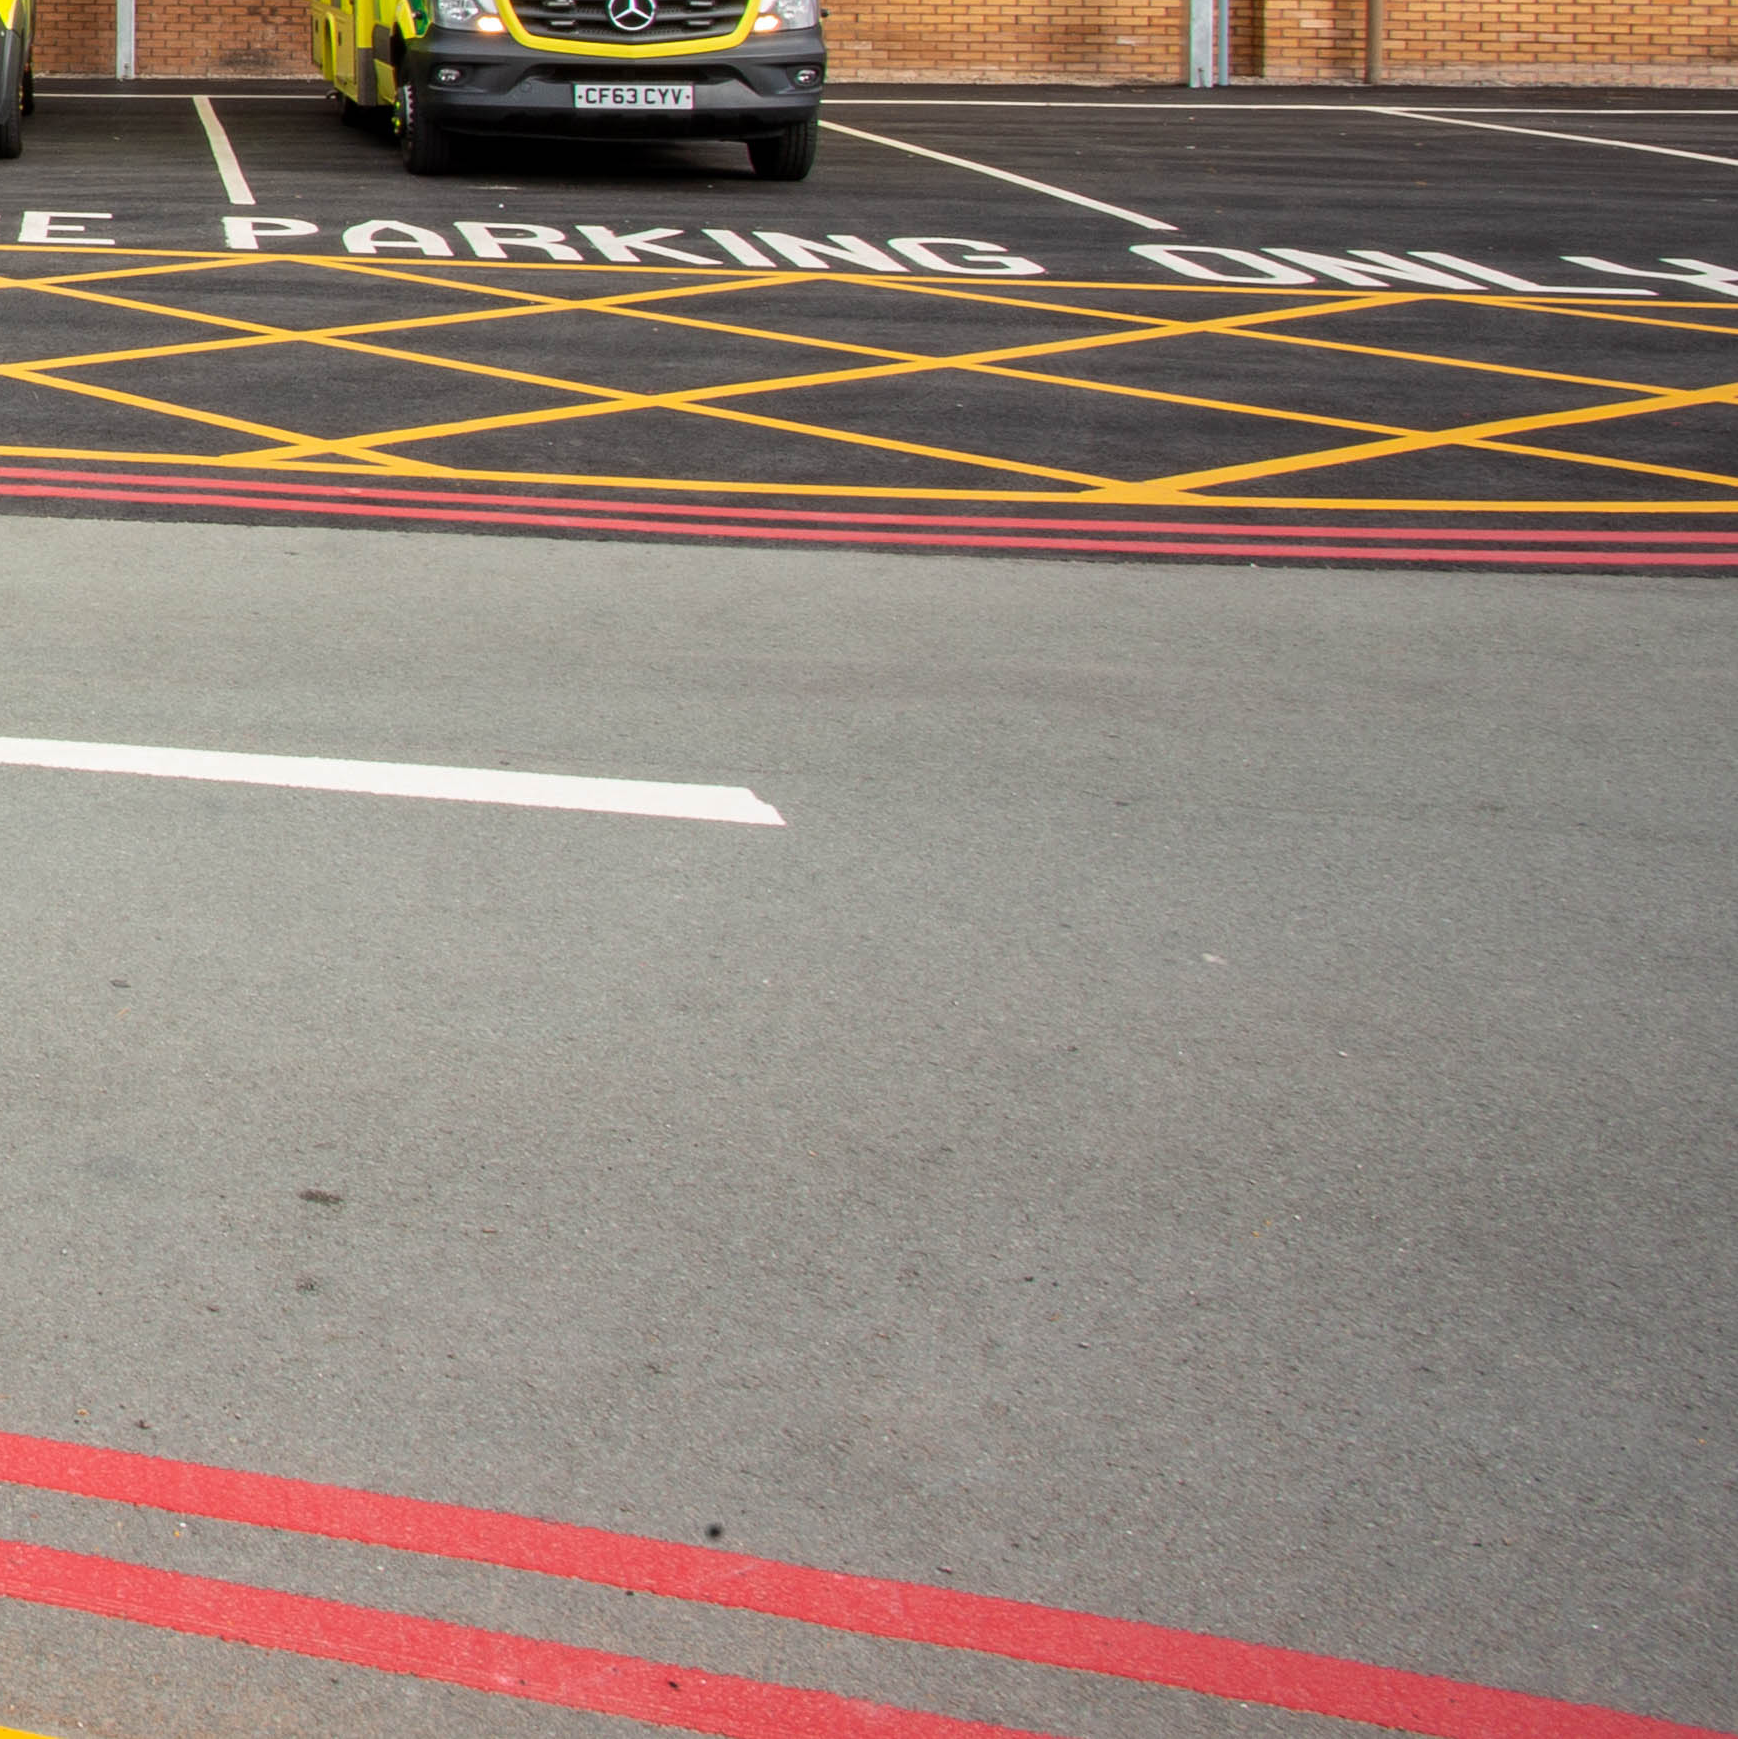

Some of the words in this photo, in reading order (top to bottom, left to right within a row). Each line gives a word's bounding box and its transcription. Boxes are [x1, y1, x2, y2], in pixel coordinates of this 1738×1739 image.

[585, 88, 638, 104] CF63
[644, 88, 683, 104] CYV
[222, 216, 1047, 276] PARKING
